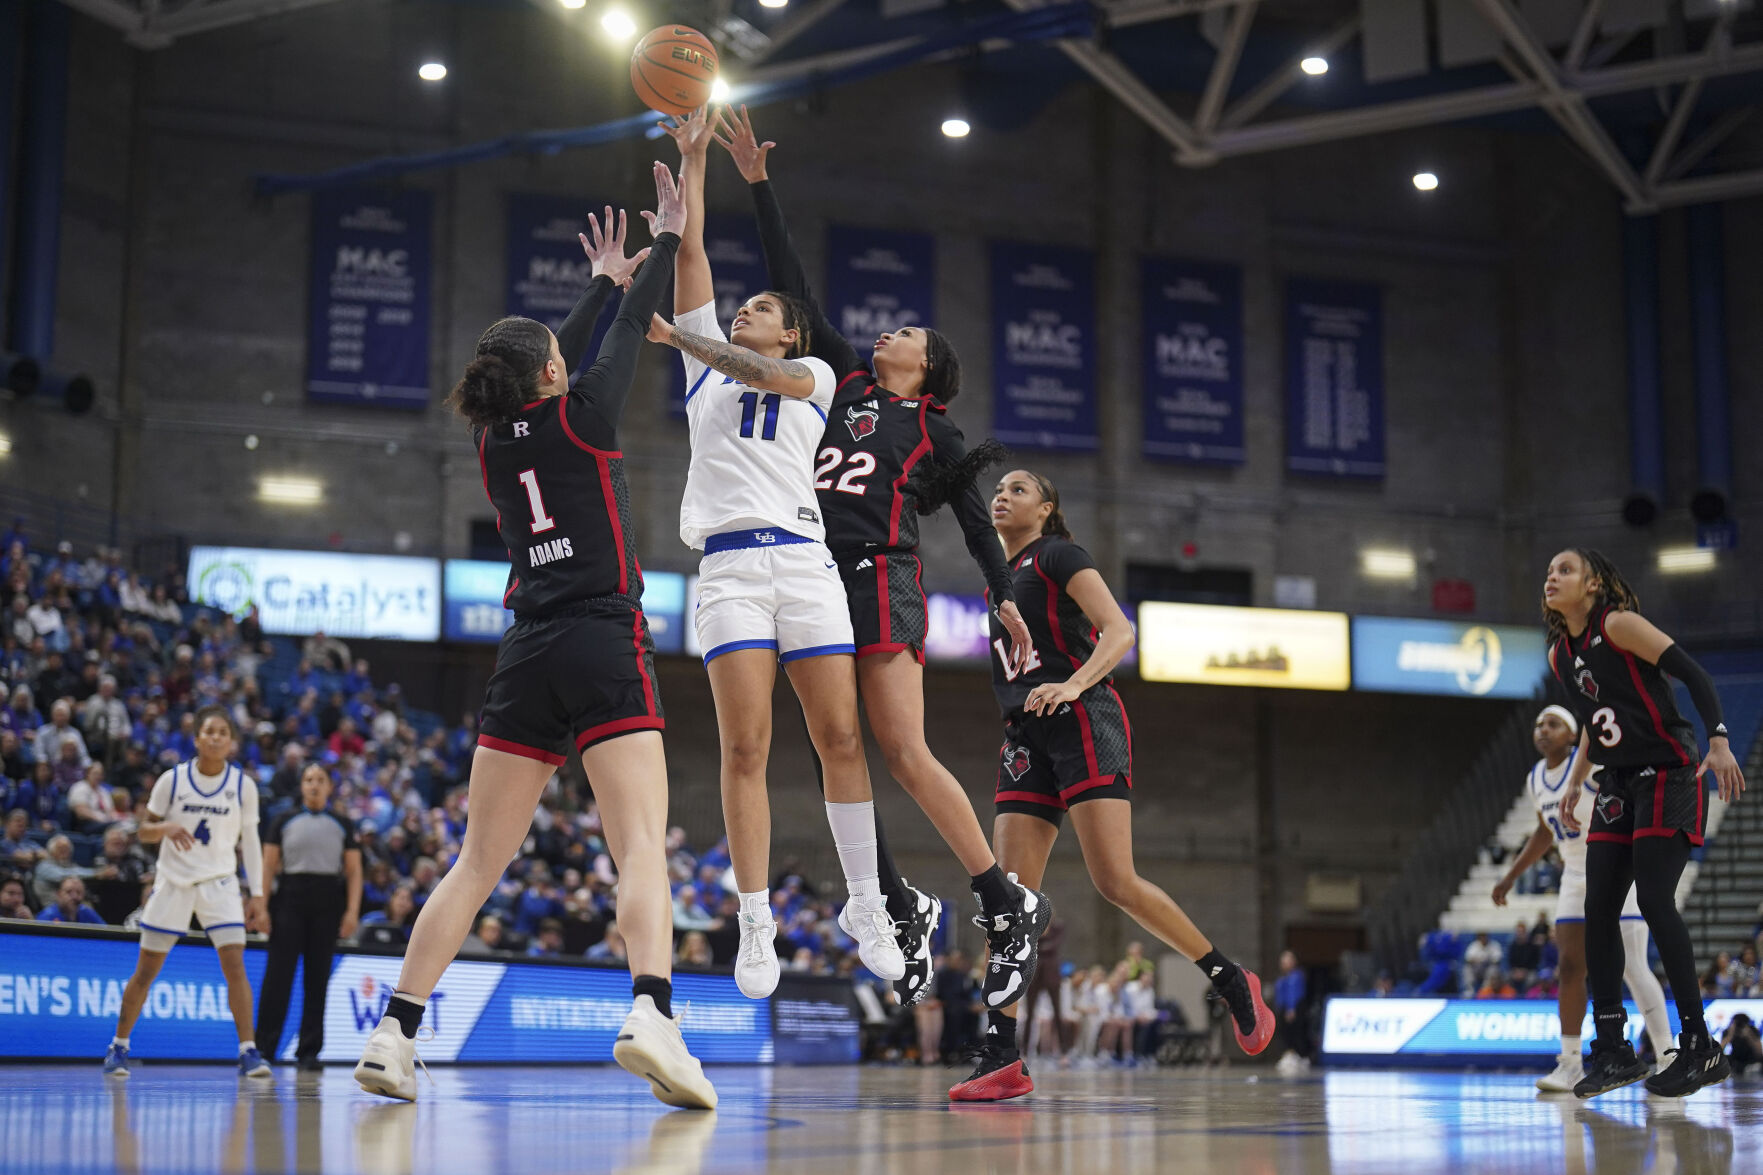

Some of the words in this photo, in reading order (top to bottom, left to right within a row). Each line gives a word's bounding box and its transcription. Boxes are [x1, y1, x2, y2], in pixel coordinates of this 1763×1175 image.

[672, 46, 715, 72] ELITE
[336, 247, 410, 277] MAC
[1006, 323, 1081, 356] MAC
[1156, 334, 1228, 367] MAC
[513, 421, 530, 438] R
[739, 392, 781, 441] 11
[813, 446, 876, 495] 22
[518, 468, 556, 535] 1
[529, 537, 574, 567] ADAMS
[754, 532, 776, 544] UB
[263, 575, 428, 618] Catalyst
[1592, 706, 1622, 748] 3
[194, 818, 211, 846] 4
[78, 977, 241, 1021] NAONAL
[1456, 1012, 1596, 1041] WOMENS
